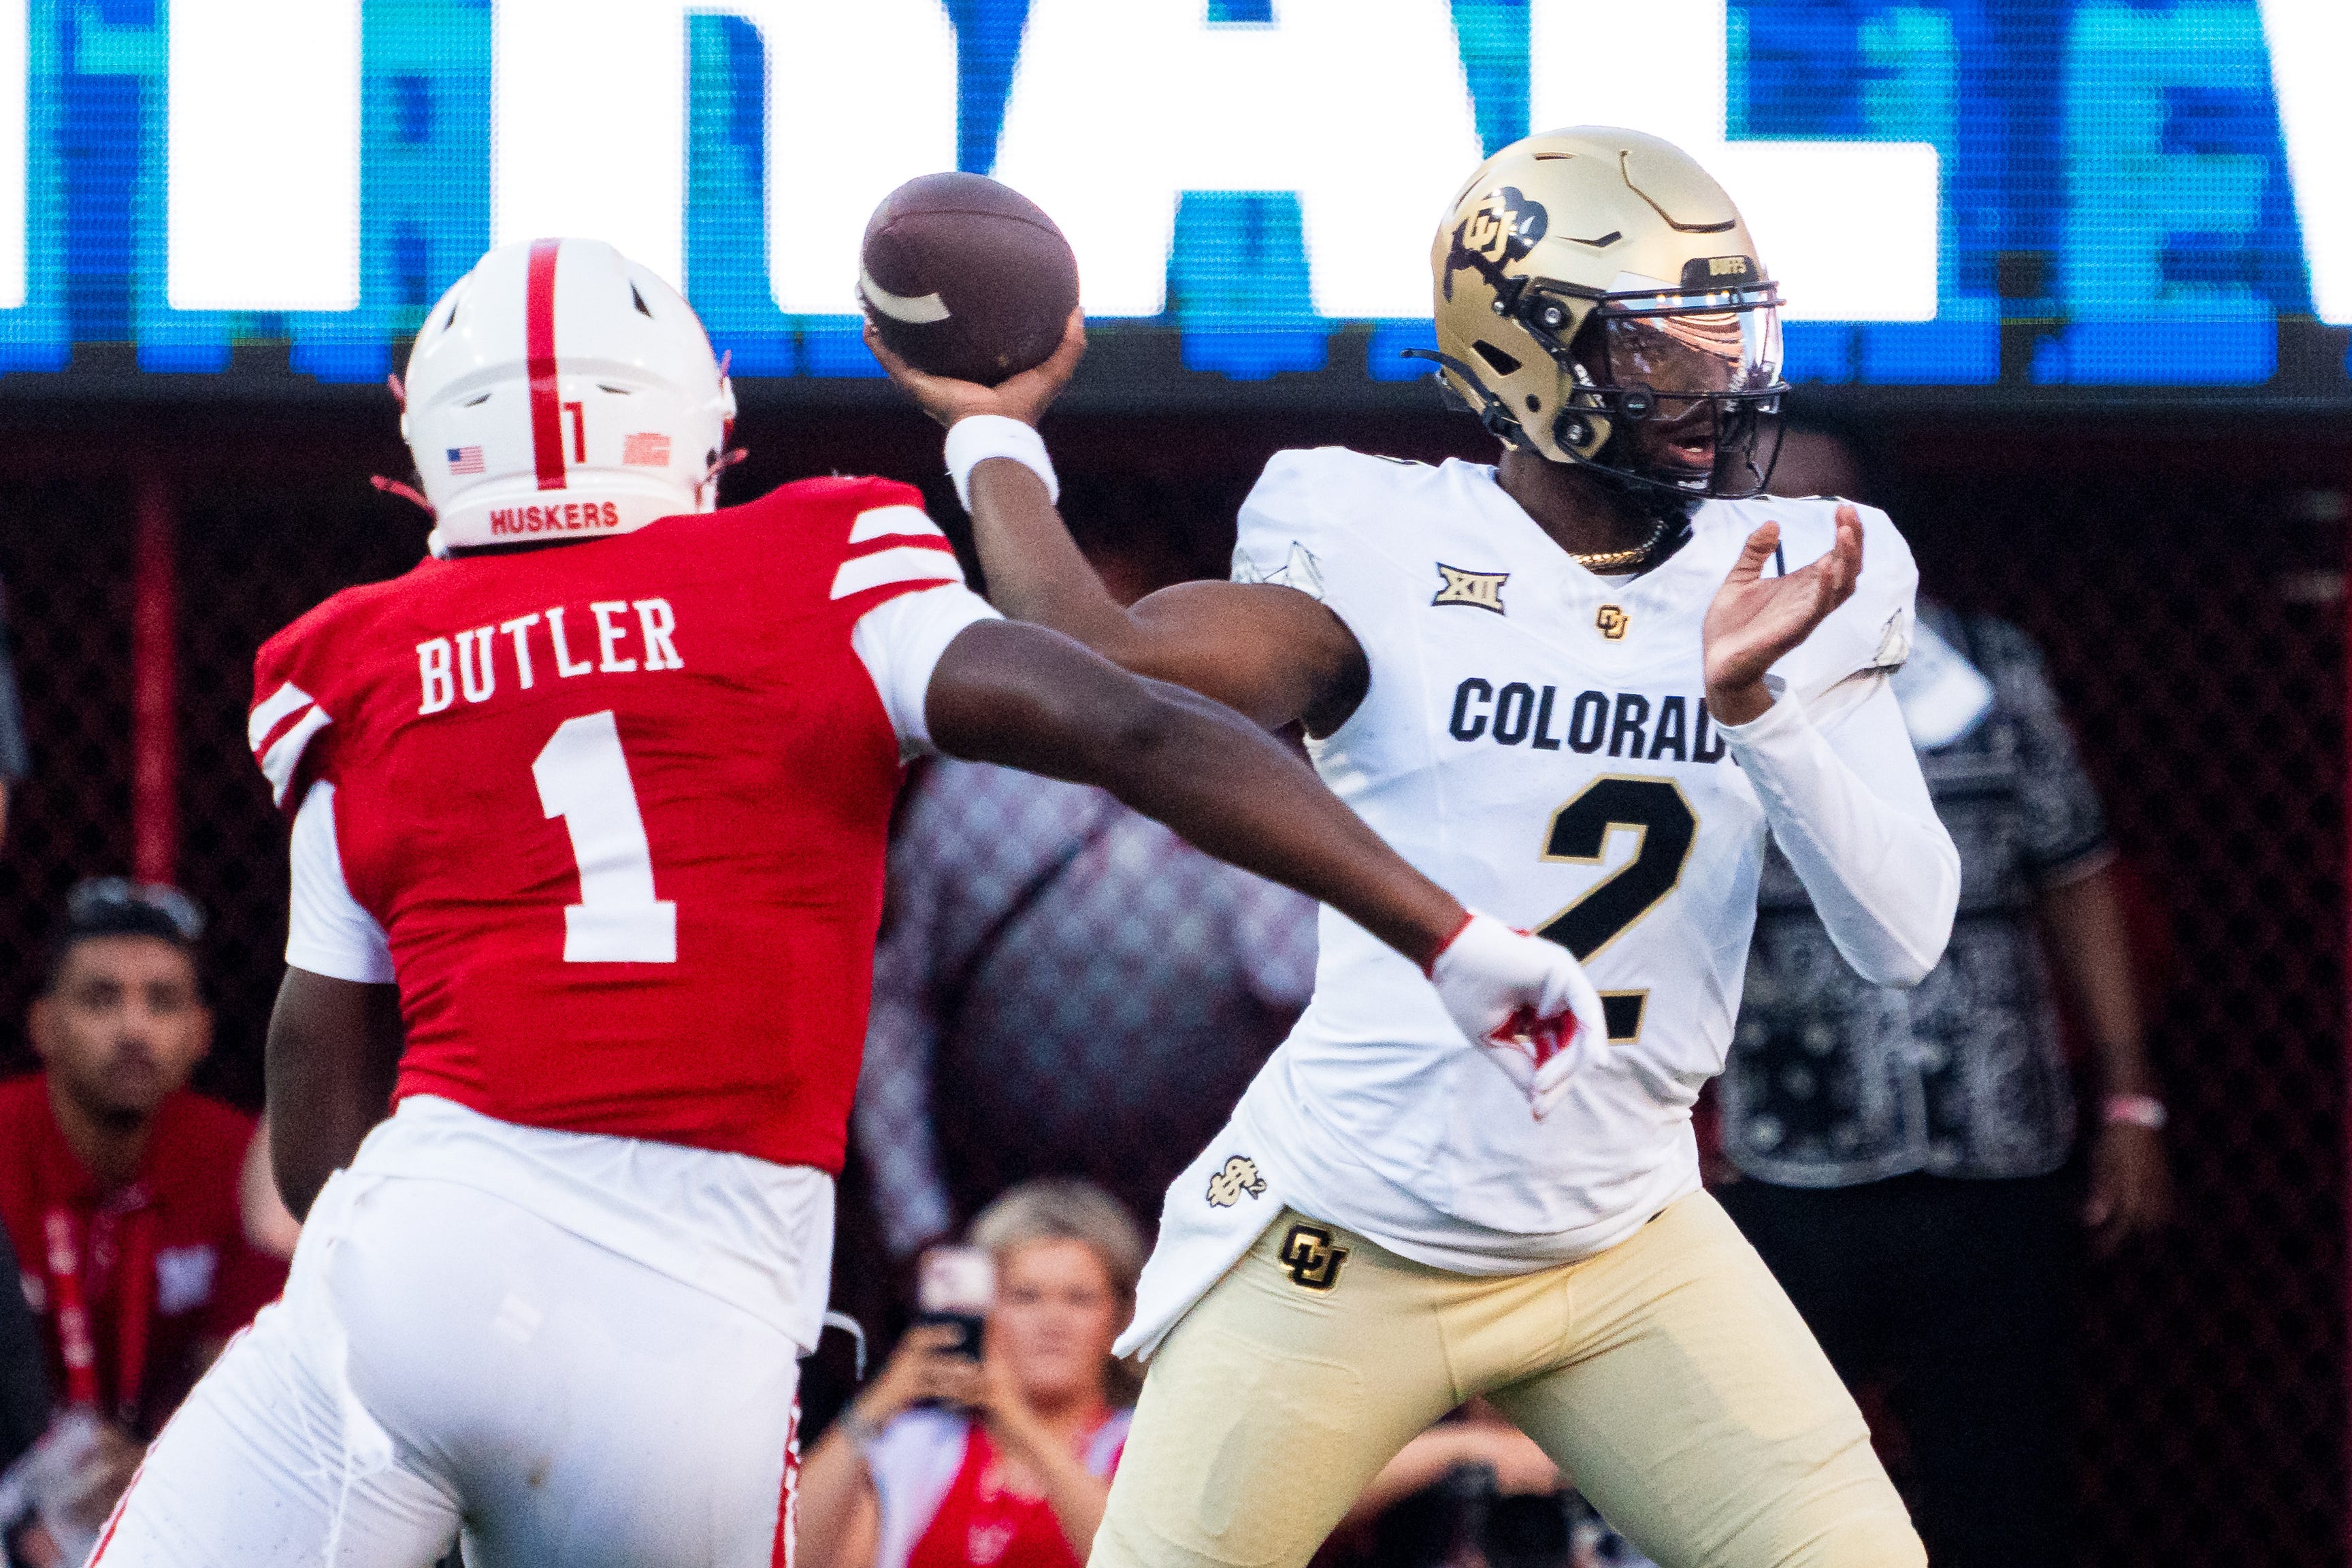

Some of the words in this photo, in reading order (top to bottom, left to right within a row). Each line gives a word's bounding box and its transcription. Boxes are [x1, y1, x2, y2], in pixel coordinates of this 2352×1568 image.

[564, 402, 585, 463] 1
[490, 502, 619, 535] HUSKERS
[416, 598, 685, 715] BUTLER
[1448, 677, 1740, 767] COLORAD
[532, 709, 677, 964] 1
[1535, 772, 1700, 1045] 2
